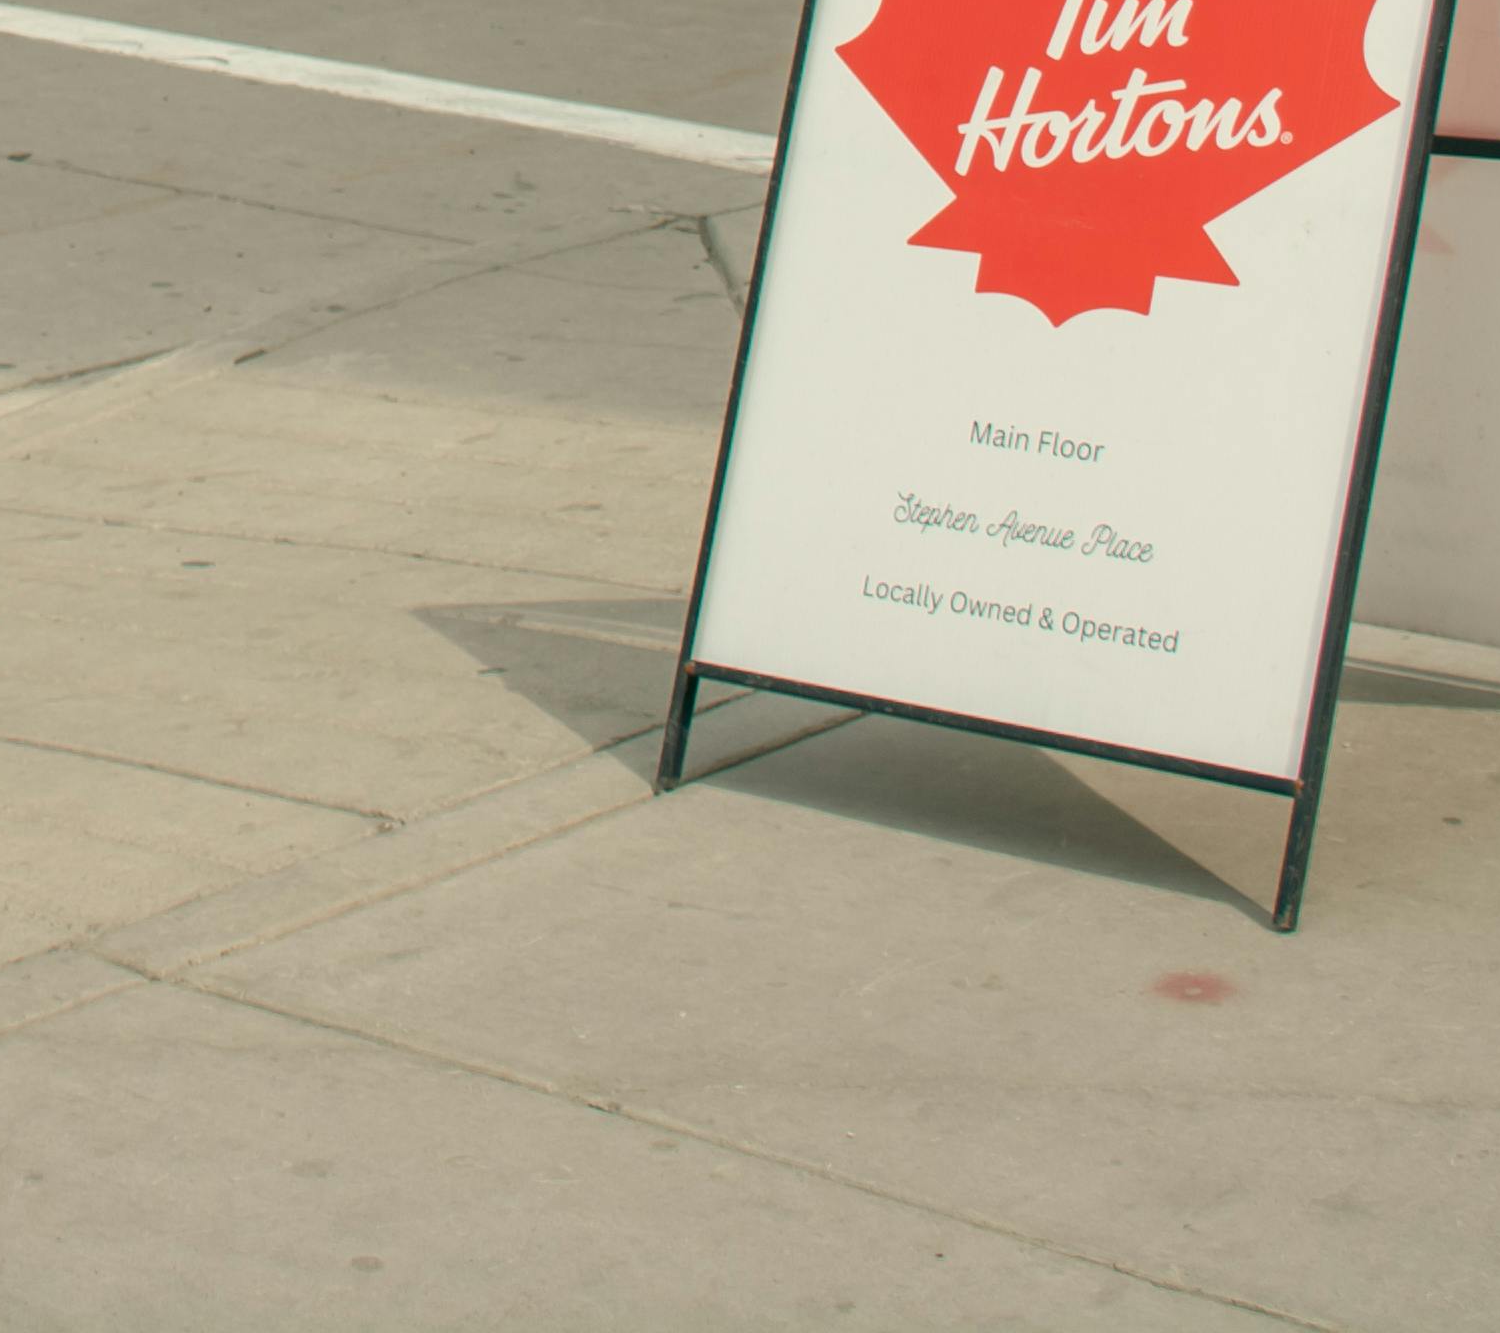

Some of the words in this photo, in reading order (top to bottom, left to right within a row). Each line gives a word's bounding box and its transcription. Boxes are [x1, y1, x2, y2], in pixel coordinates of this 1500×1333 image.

[954, 65, 1283, 177] Hortons
[970, 421, 1030, 452] Main
[1038, 431, 1105, 462] Floor
[893, 490, 980, 534] Stephen
[986, 509, 1075, 548] Avenue
[1080, 523, 1154, 563] Place
[862, 576, 944, 615] Locally
[950, 591, 1033, 627] Owned
[1038, 607, 1054, 631] &
[1061, 611, 1180, 655] Operated
